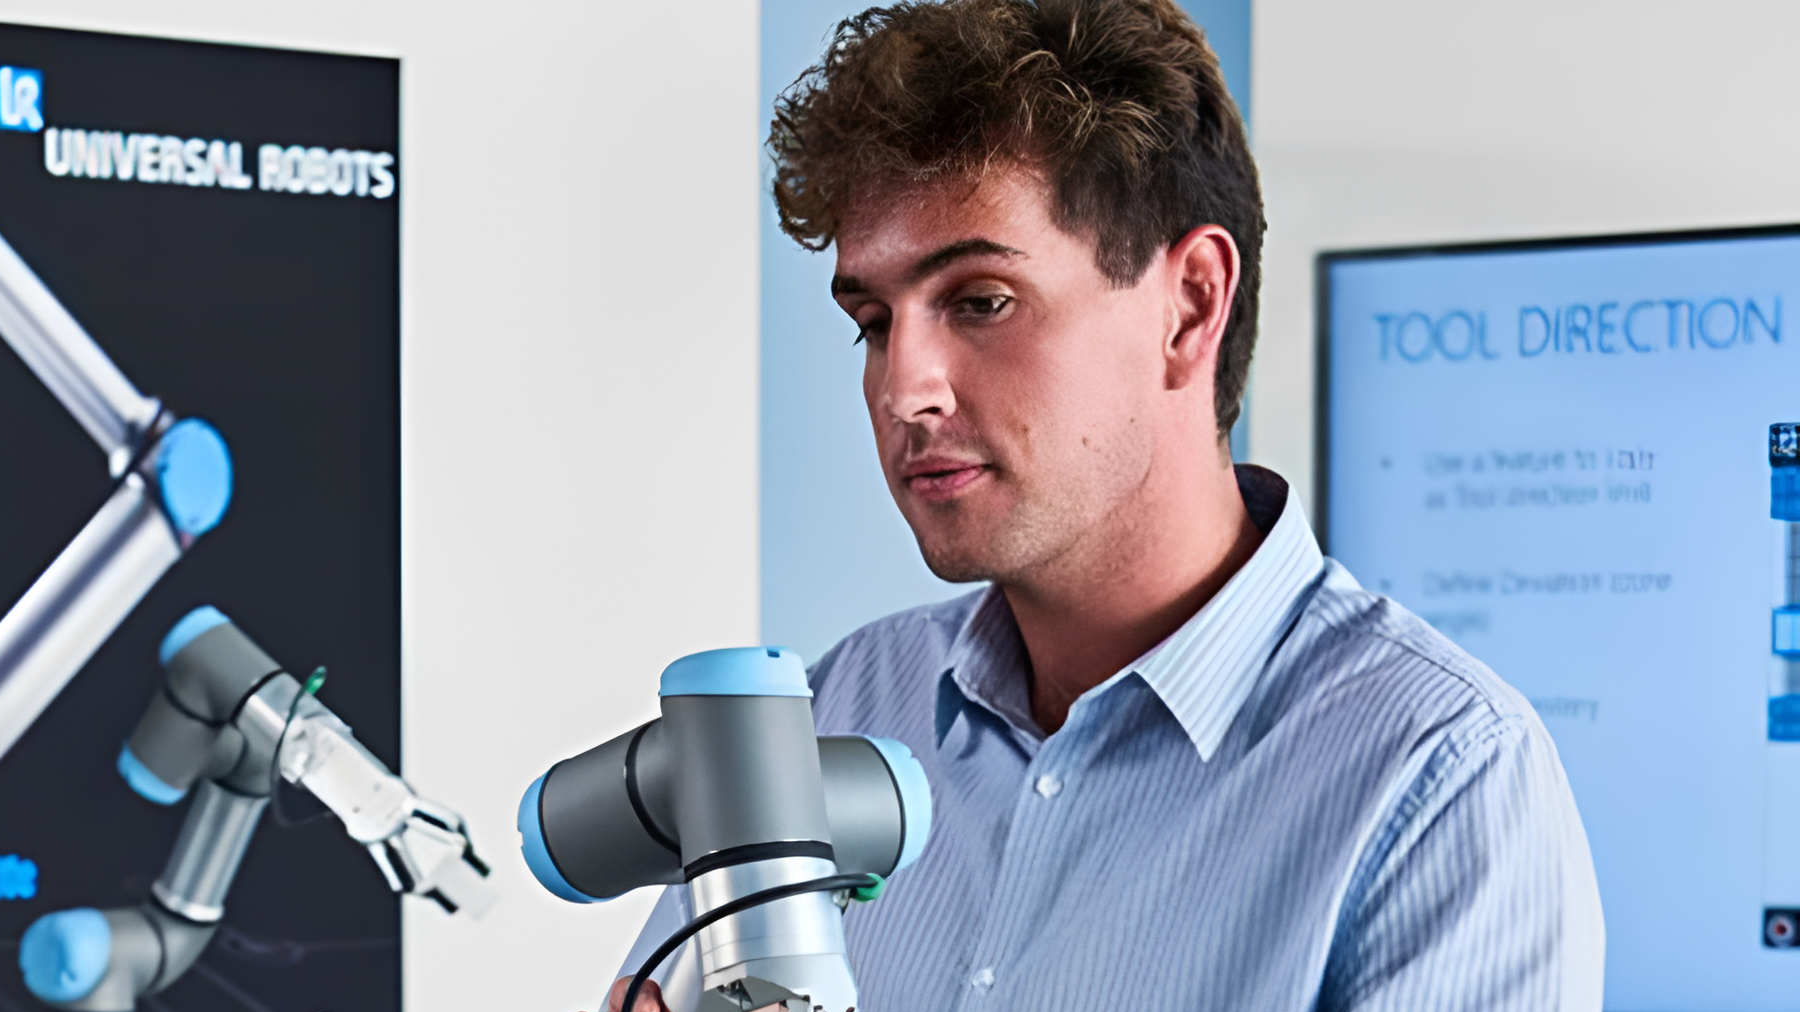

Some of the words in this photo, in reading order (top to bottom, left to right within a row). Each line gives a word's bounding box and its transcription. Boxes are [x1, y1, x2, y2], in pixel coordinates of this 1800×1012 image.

[44, 127, 253, 190] UNIVERSAL
[258, 143, 395, 199] ROBOTS
[1374, 309, 1500, 363] TOOL
[1518, 296, 1782, 358] DIRECTION
